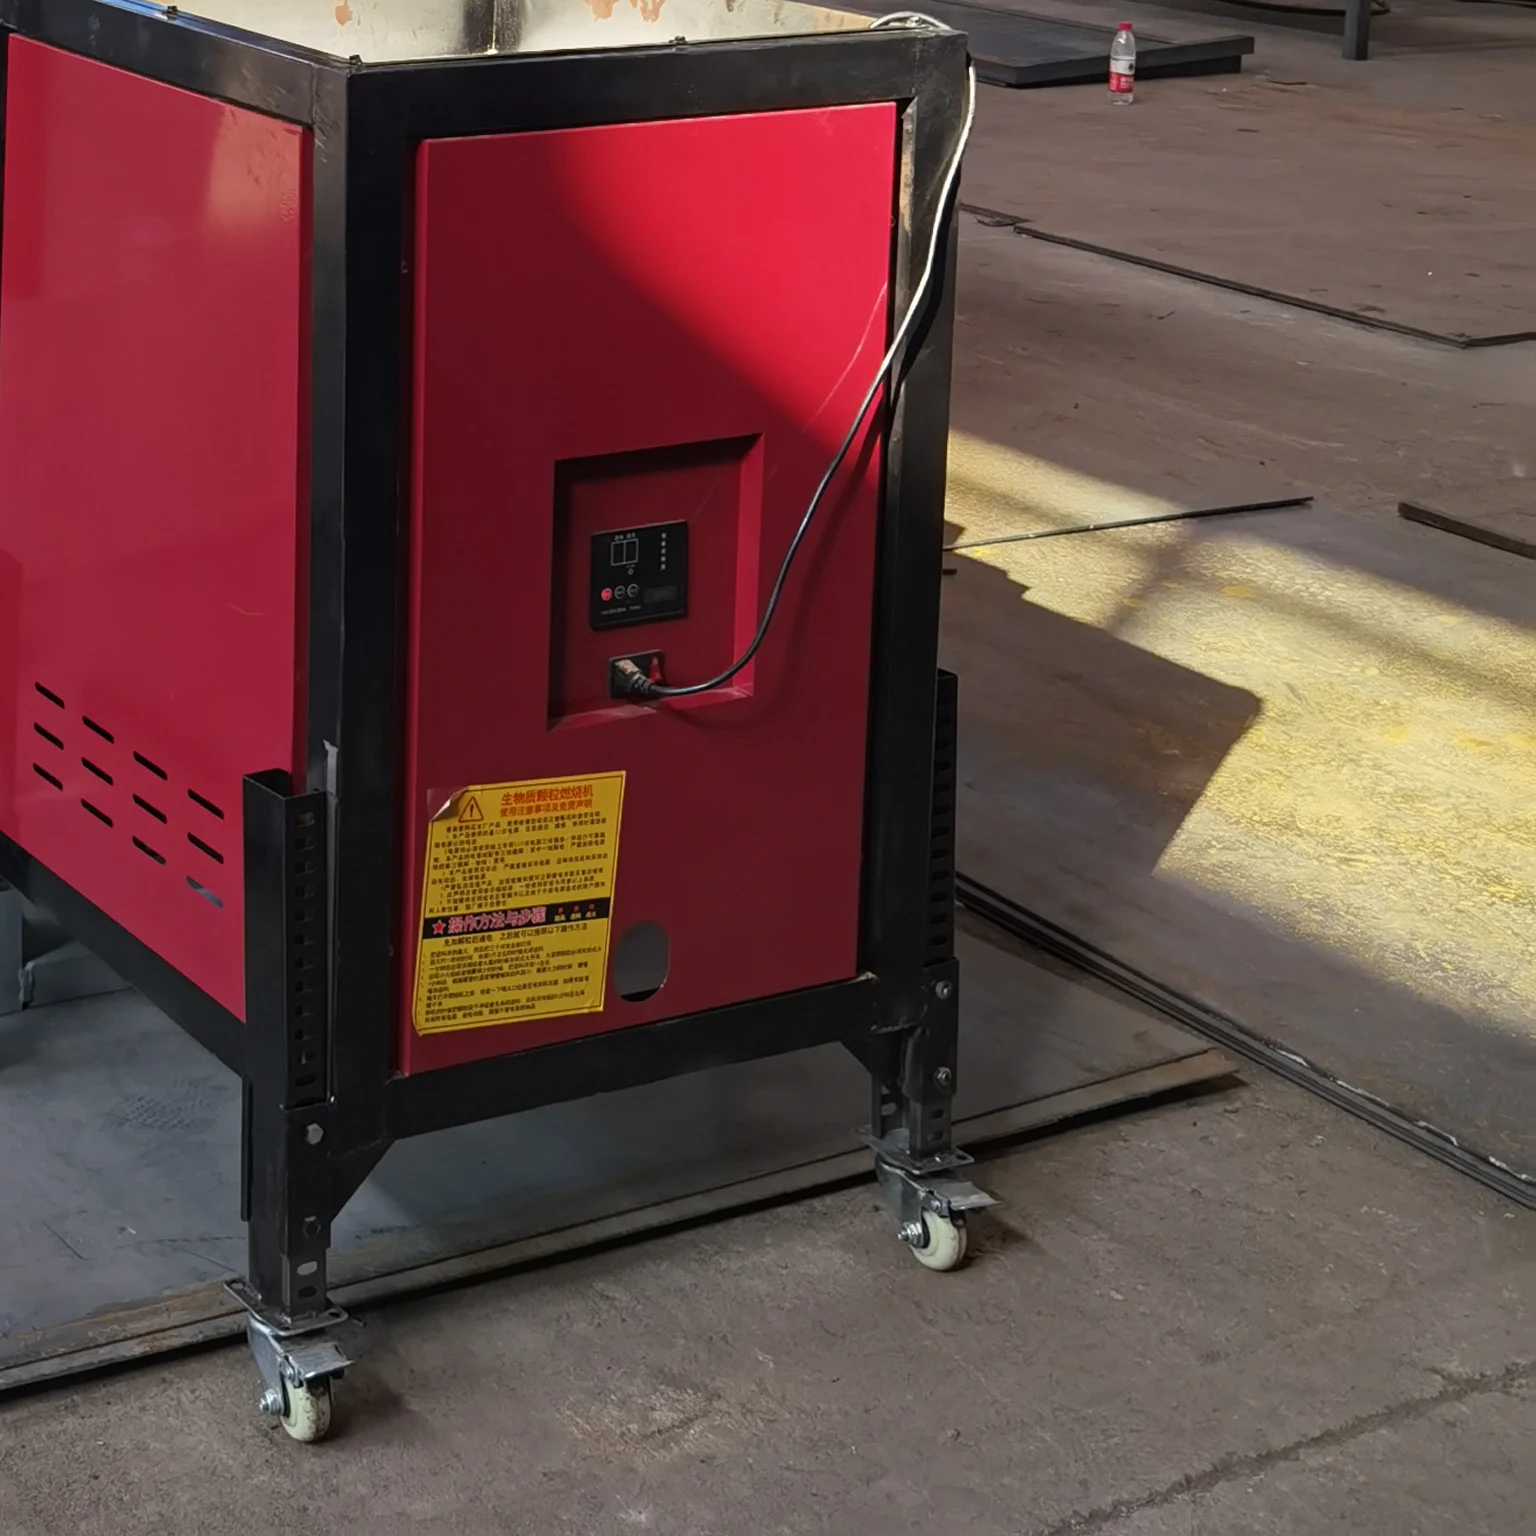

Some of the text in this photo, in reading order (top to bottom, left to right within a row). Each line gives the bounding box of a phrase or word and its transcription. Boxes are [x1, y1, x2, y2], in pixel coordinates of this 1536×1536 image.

[501, 784, 594, 806] 生物质颗粒燃烧机
